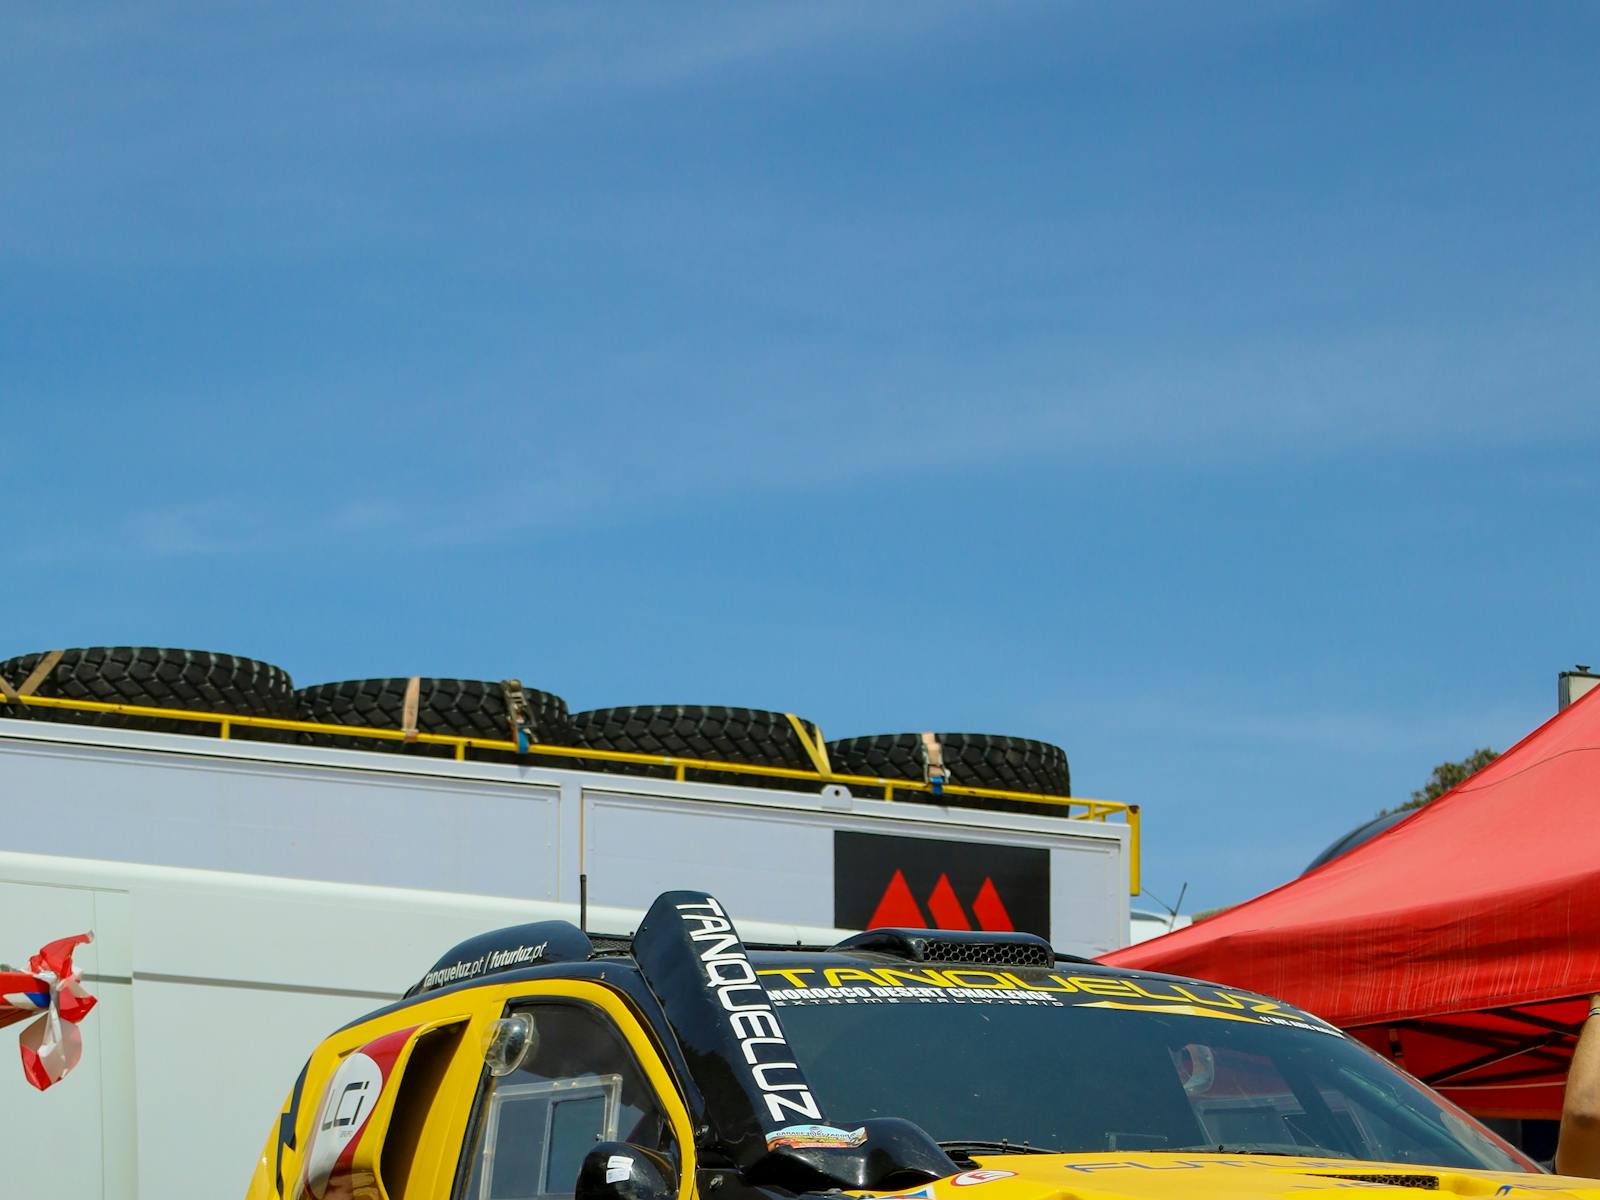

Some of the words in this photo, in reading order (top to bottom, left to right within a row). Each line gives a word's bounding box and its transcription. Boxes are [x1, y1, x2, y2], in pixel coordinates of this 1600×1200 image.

[490, 941, 548, 969] futurluz.pt
[676, 897, 823, 1122] TANQUELUZ
[757, 967, 1304, 1021] TANQUELUZ
[766, 987, 866, 1001] MOROCCO
[868, 987, 946, 999] DESERT
[946, 988, 1058, 1003] CHALLENGE
